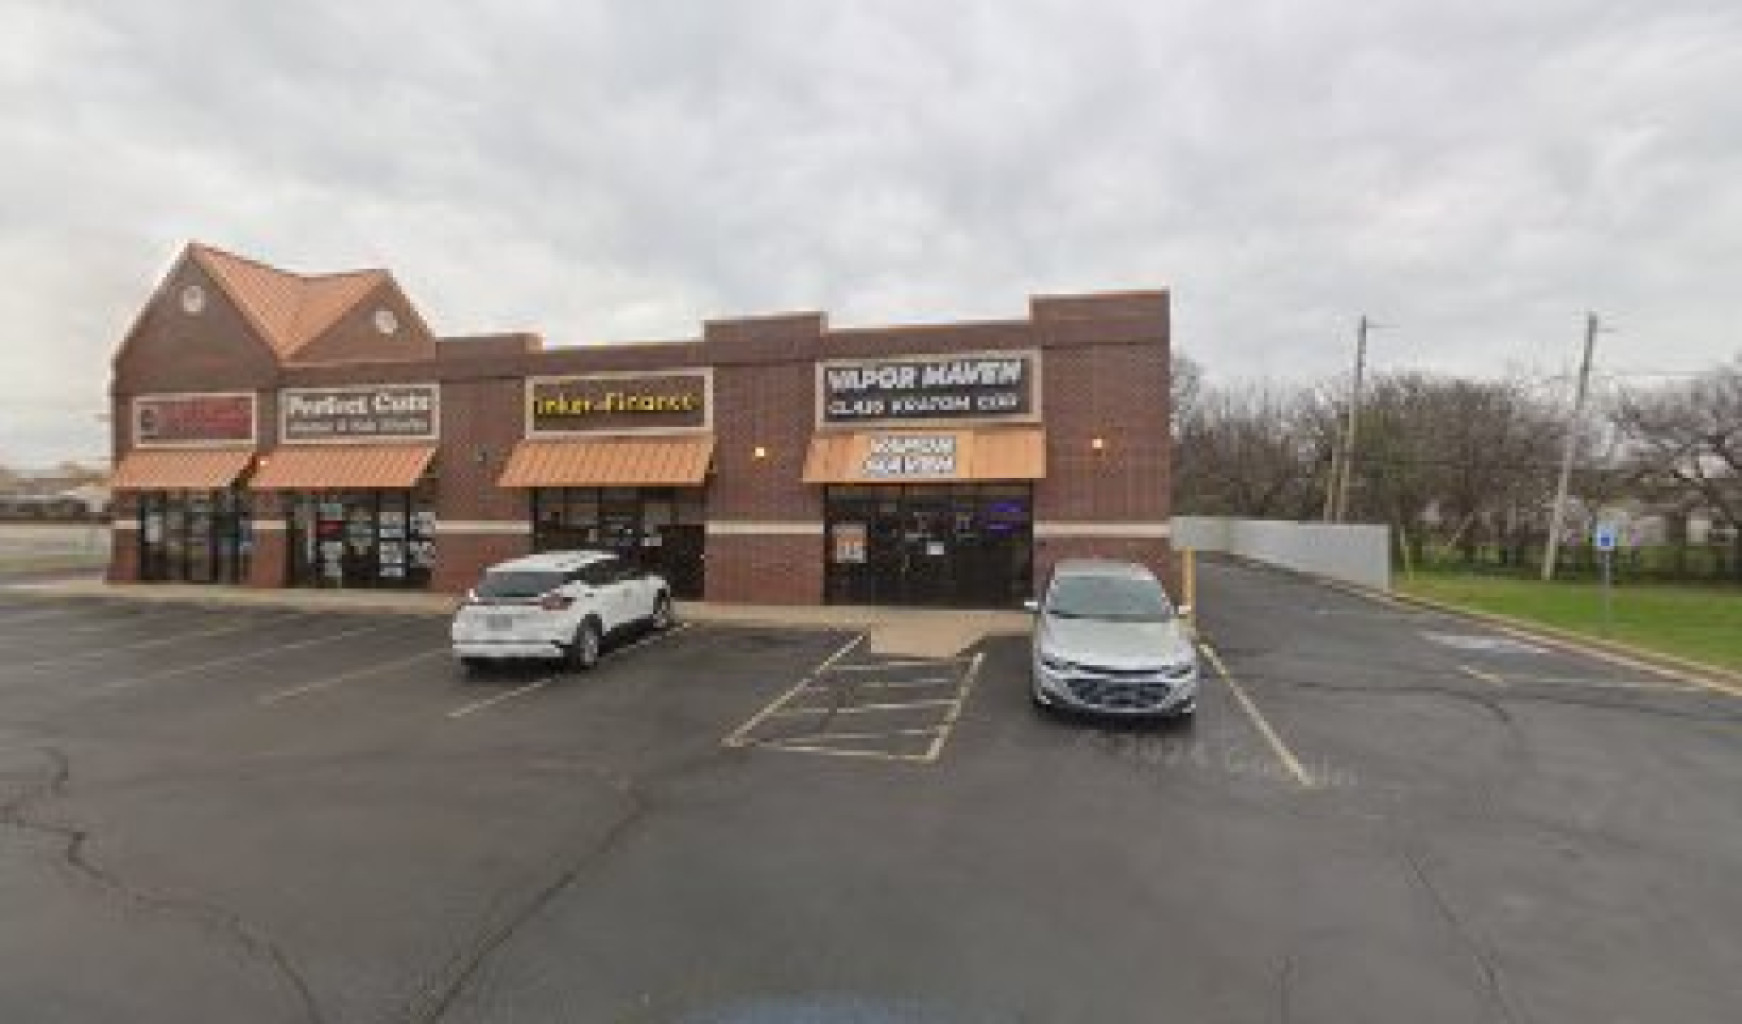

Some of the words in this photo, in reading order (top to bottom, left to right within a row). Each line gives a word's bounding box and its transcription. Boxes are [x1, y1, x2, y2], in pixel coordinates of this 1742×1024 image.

[827, 367, 916, 391] VAPOR
[921, 360, 1021, 387] MAVEN
[287, 395, 368, 418] Perfect
[371, 391, 430, 412] Cuts
